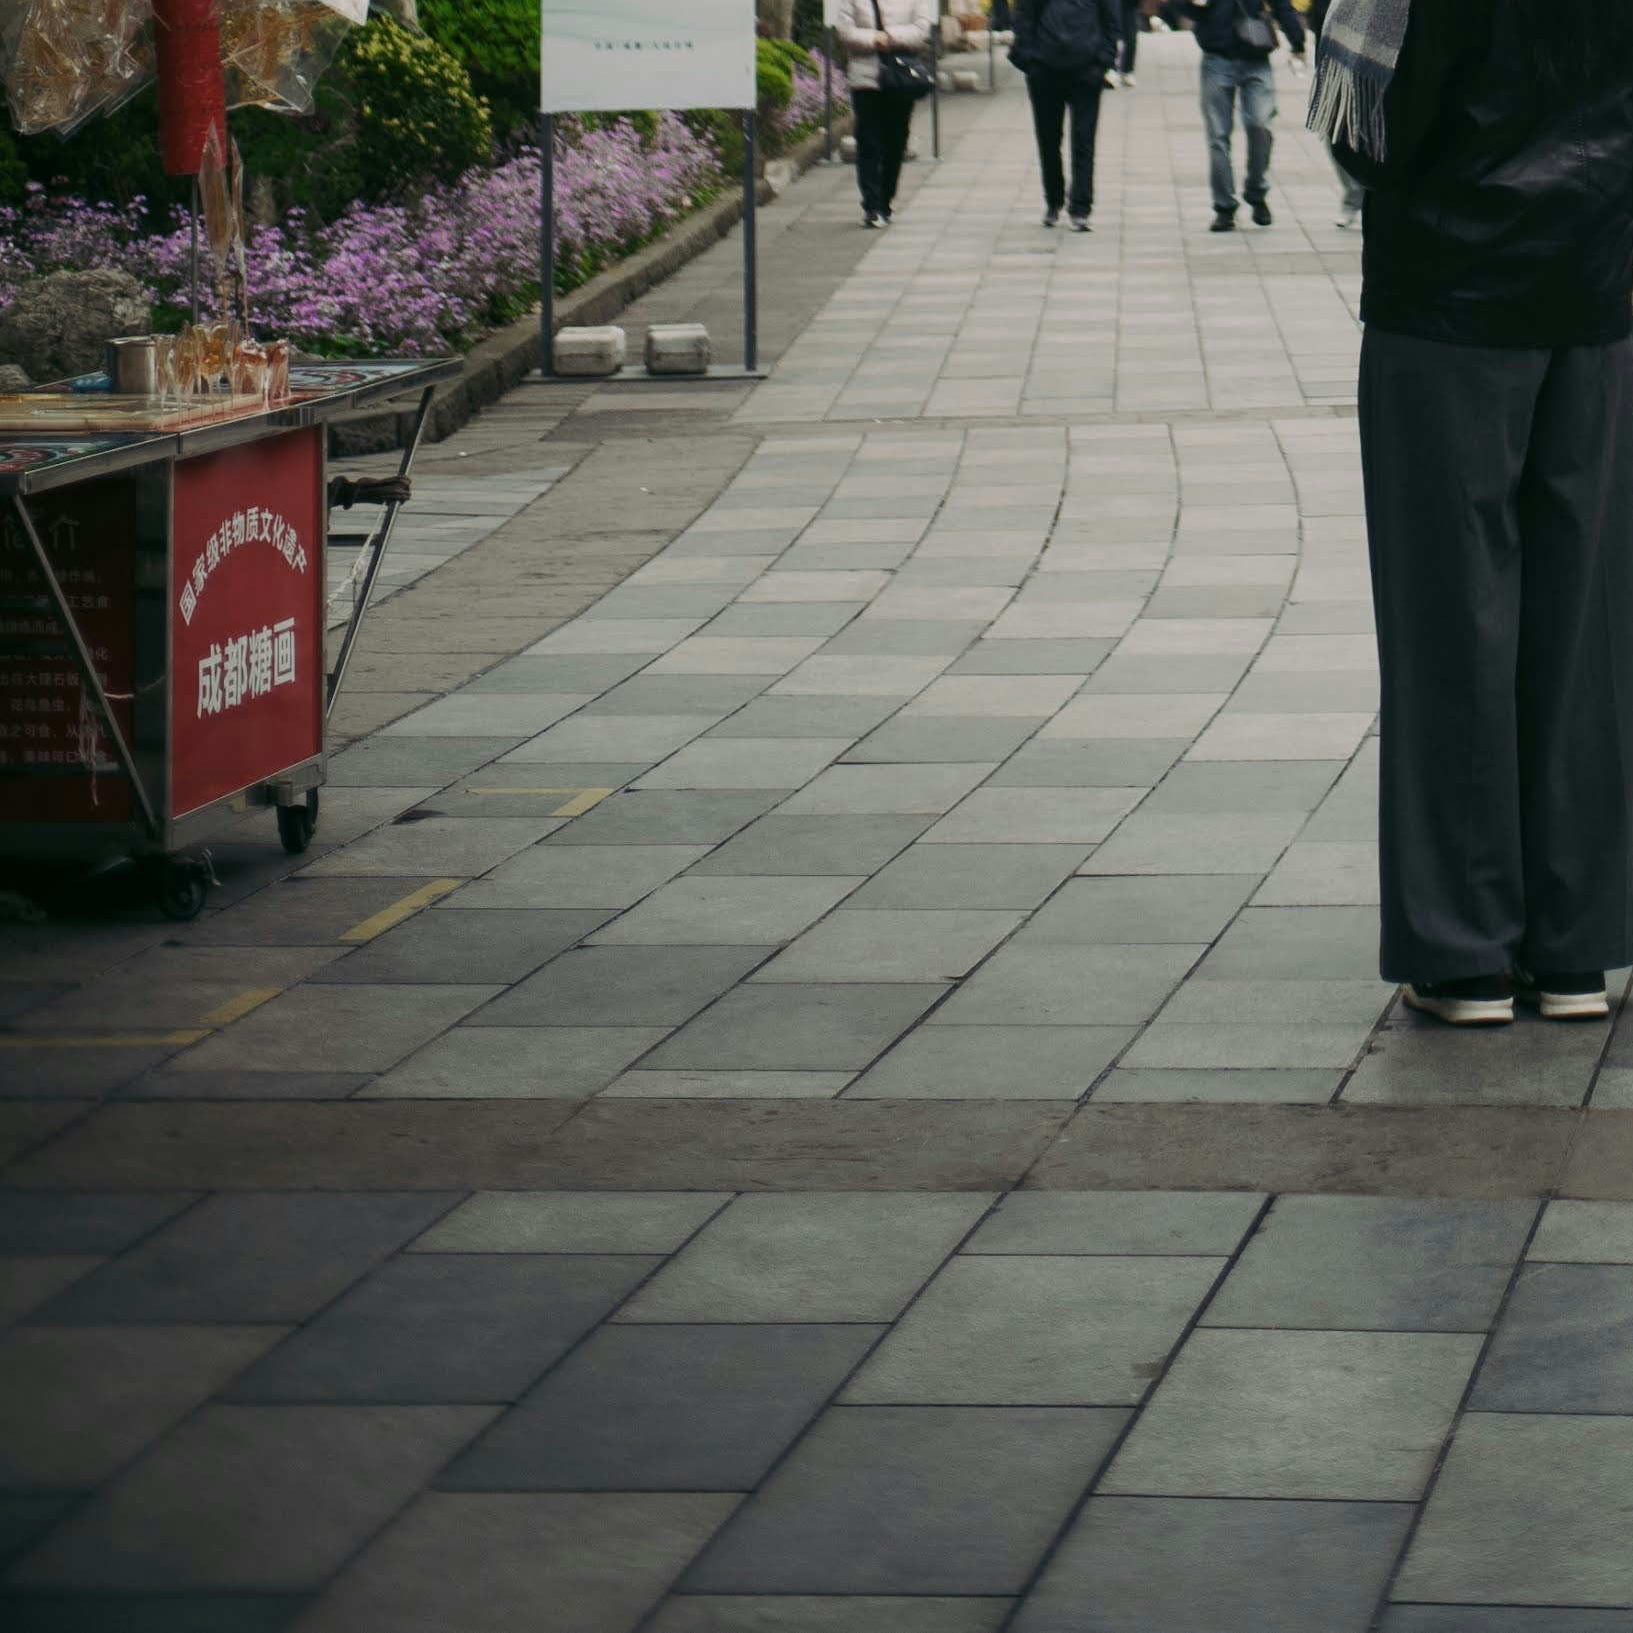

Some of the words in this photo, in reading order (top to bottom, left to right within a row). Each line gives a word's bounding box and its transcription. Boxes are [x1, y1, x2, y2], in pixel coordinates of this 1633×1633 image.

[178, 505, 308, 626] 国家级非物质文化遗产
[196, 617, 296, 720] 成都糖画
